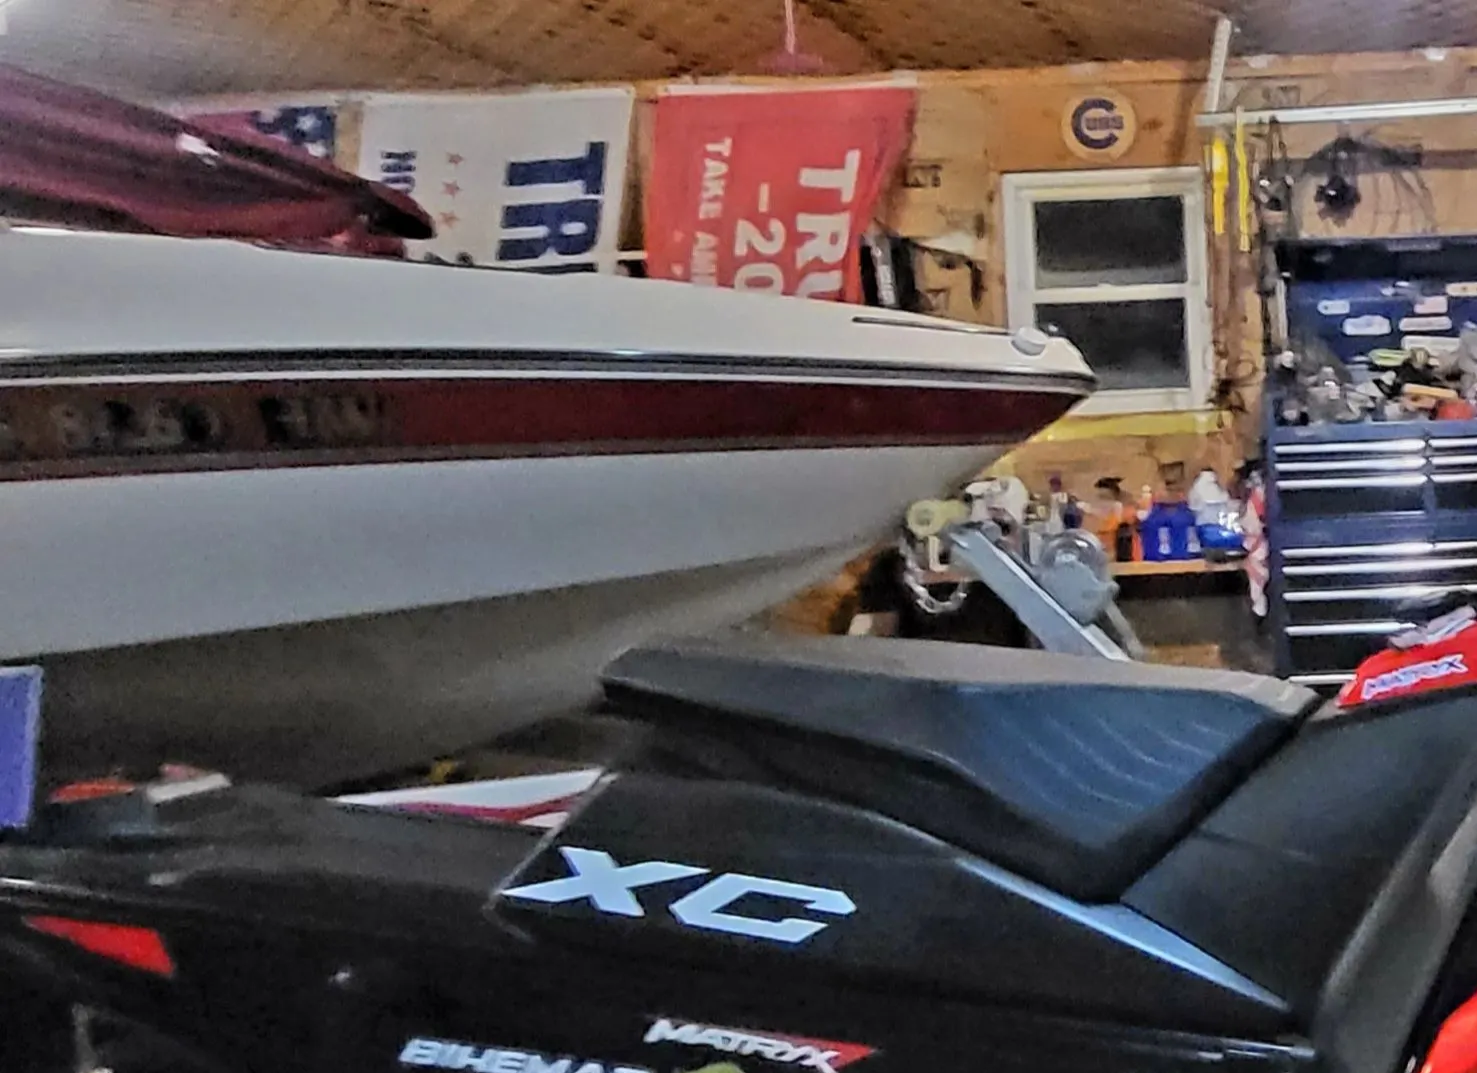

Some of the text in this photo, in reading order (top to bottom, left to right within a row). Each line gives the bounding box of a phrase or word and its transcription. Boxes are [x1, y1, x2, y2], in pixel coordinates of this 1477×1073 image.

[497, 141, 606, 273] TR
[698, 137, 732, 220] TAKE
[501, 846, 856, 943] XC
